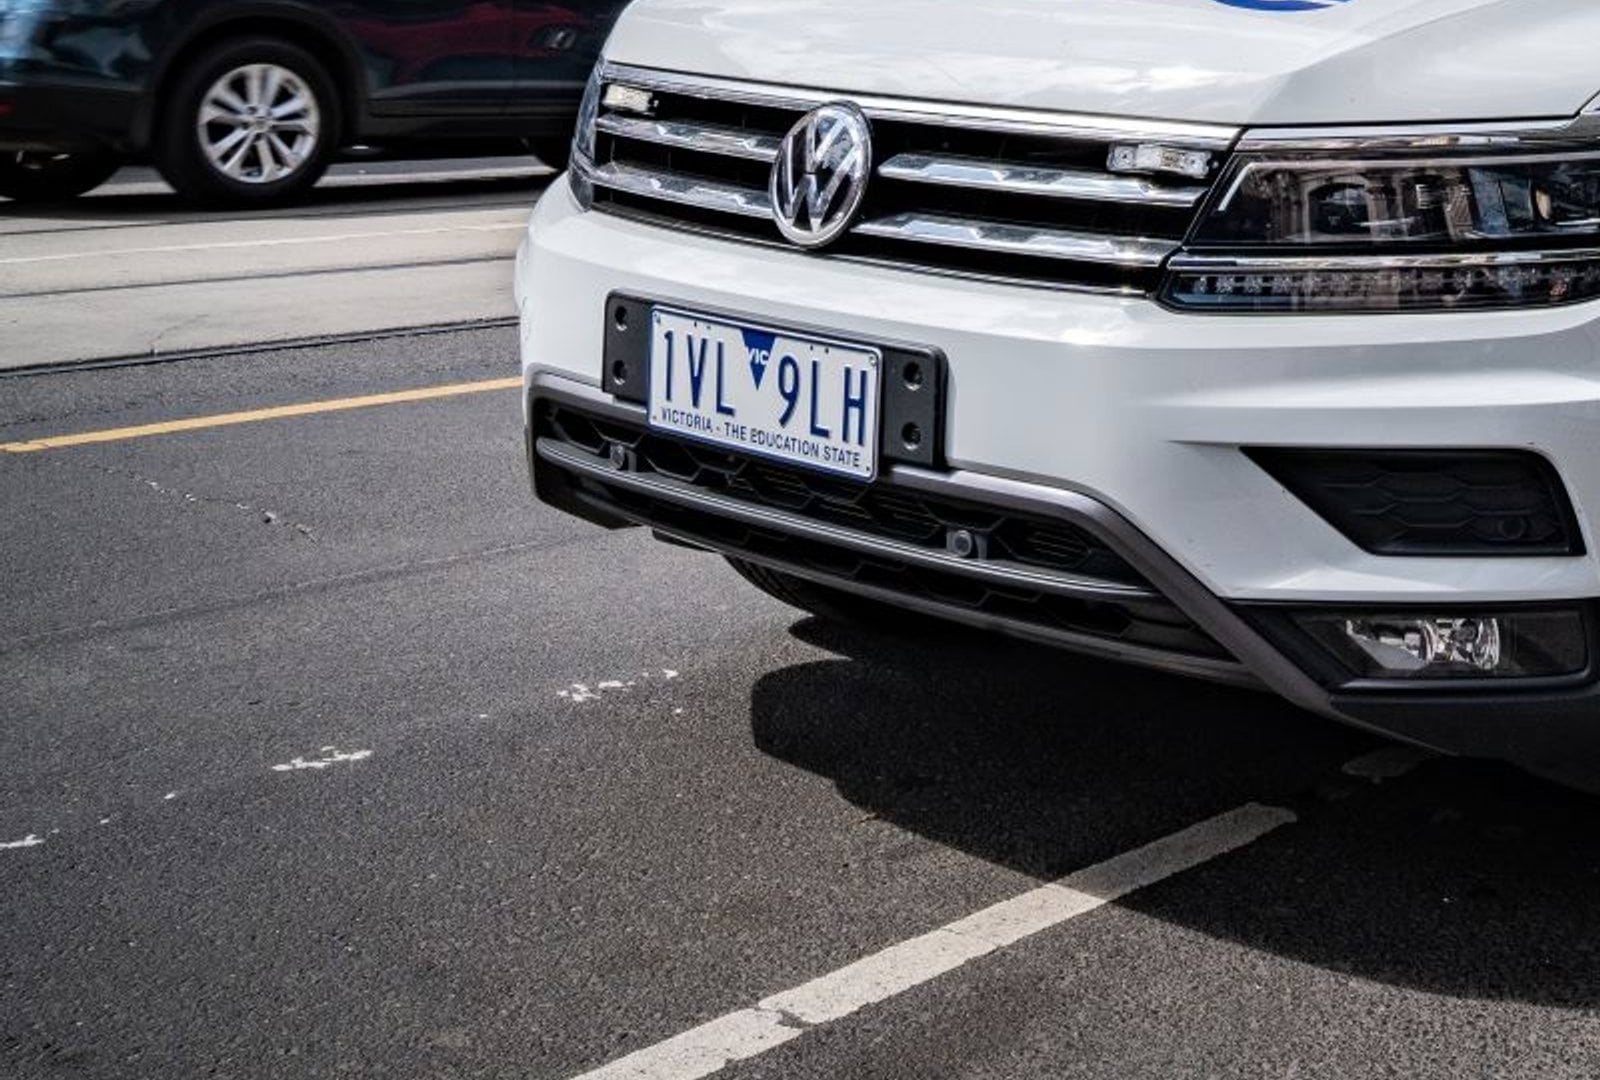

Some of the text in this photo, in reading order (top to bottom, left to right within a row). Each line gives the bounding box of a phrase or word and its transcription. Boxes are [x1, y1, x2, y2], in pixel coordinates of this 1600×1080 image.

[745, 346, 770, 366] VIC
[664, 331, 867, 446] 1VL 9LH
[662, 408, 713, 433] VICTORIA
[724, 422, 747, 443] THE
[750, 428, 820, 458] EDUCATION
[823, 446, 860, 468] STATE
